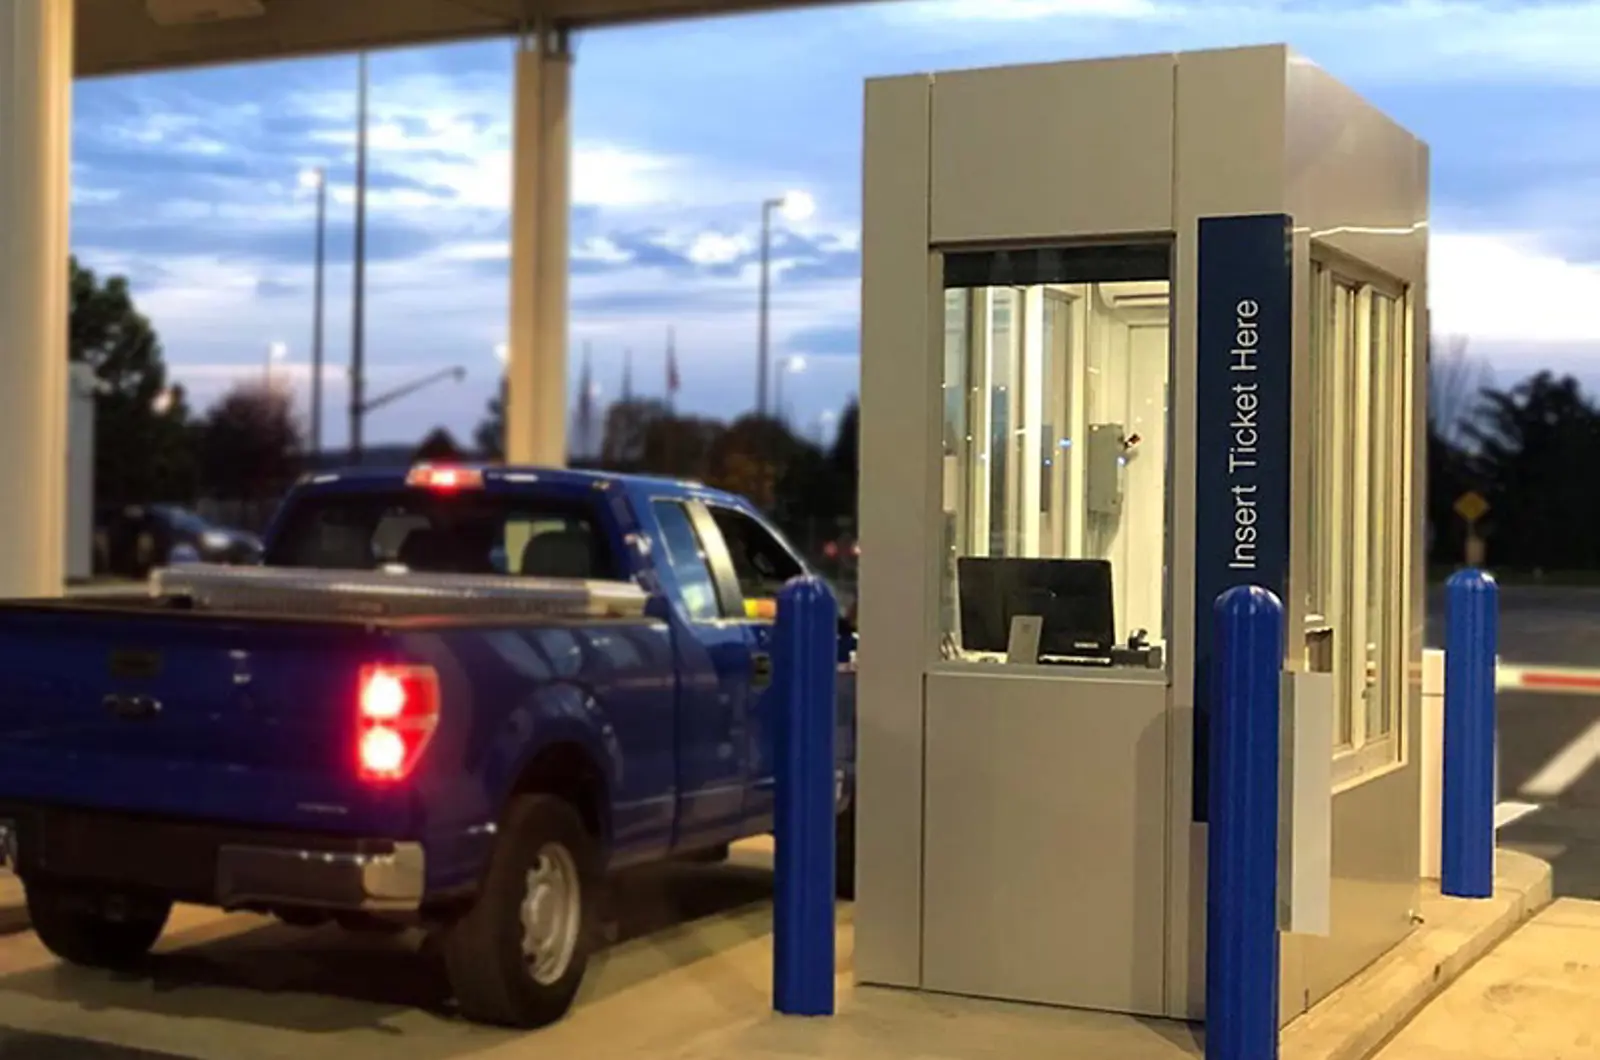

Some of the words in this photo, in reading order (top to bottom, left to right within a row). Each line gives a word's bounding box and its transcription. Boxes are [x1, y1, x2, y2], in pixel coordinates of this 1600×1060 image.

[1230, 299, 1259, 371] Here
[1228, 383, 1258, 474] Ticket
[1228, 485, 1257, 569] Insert
